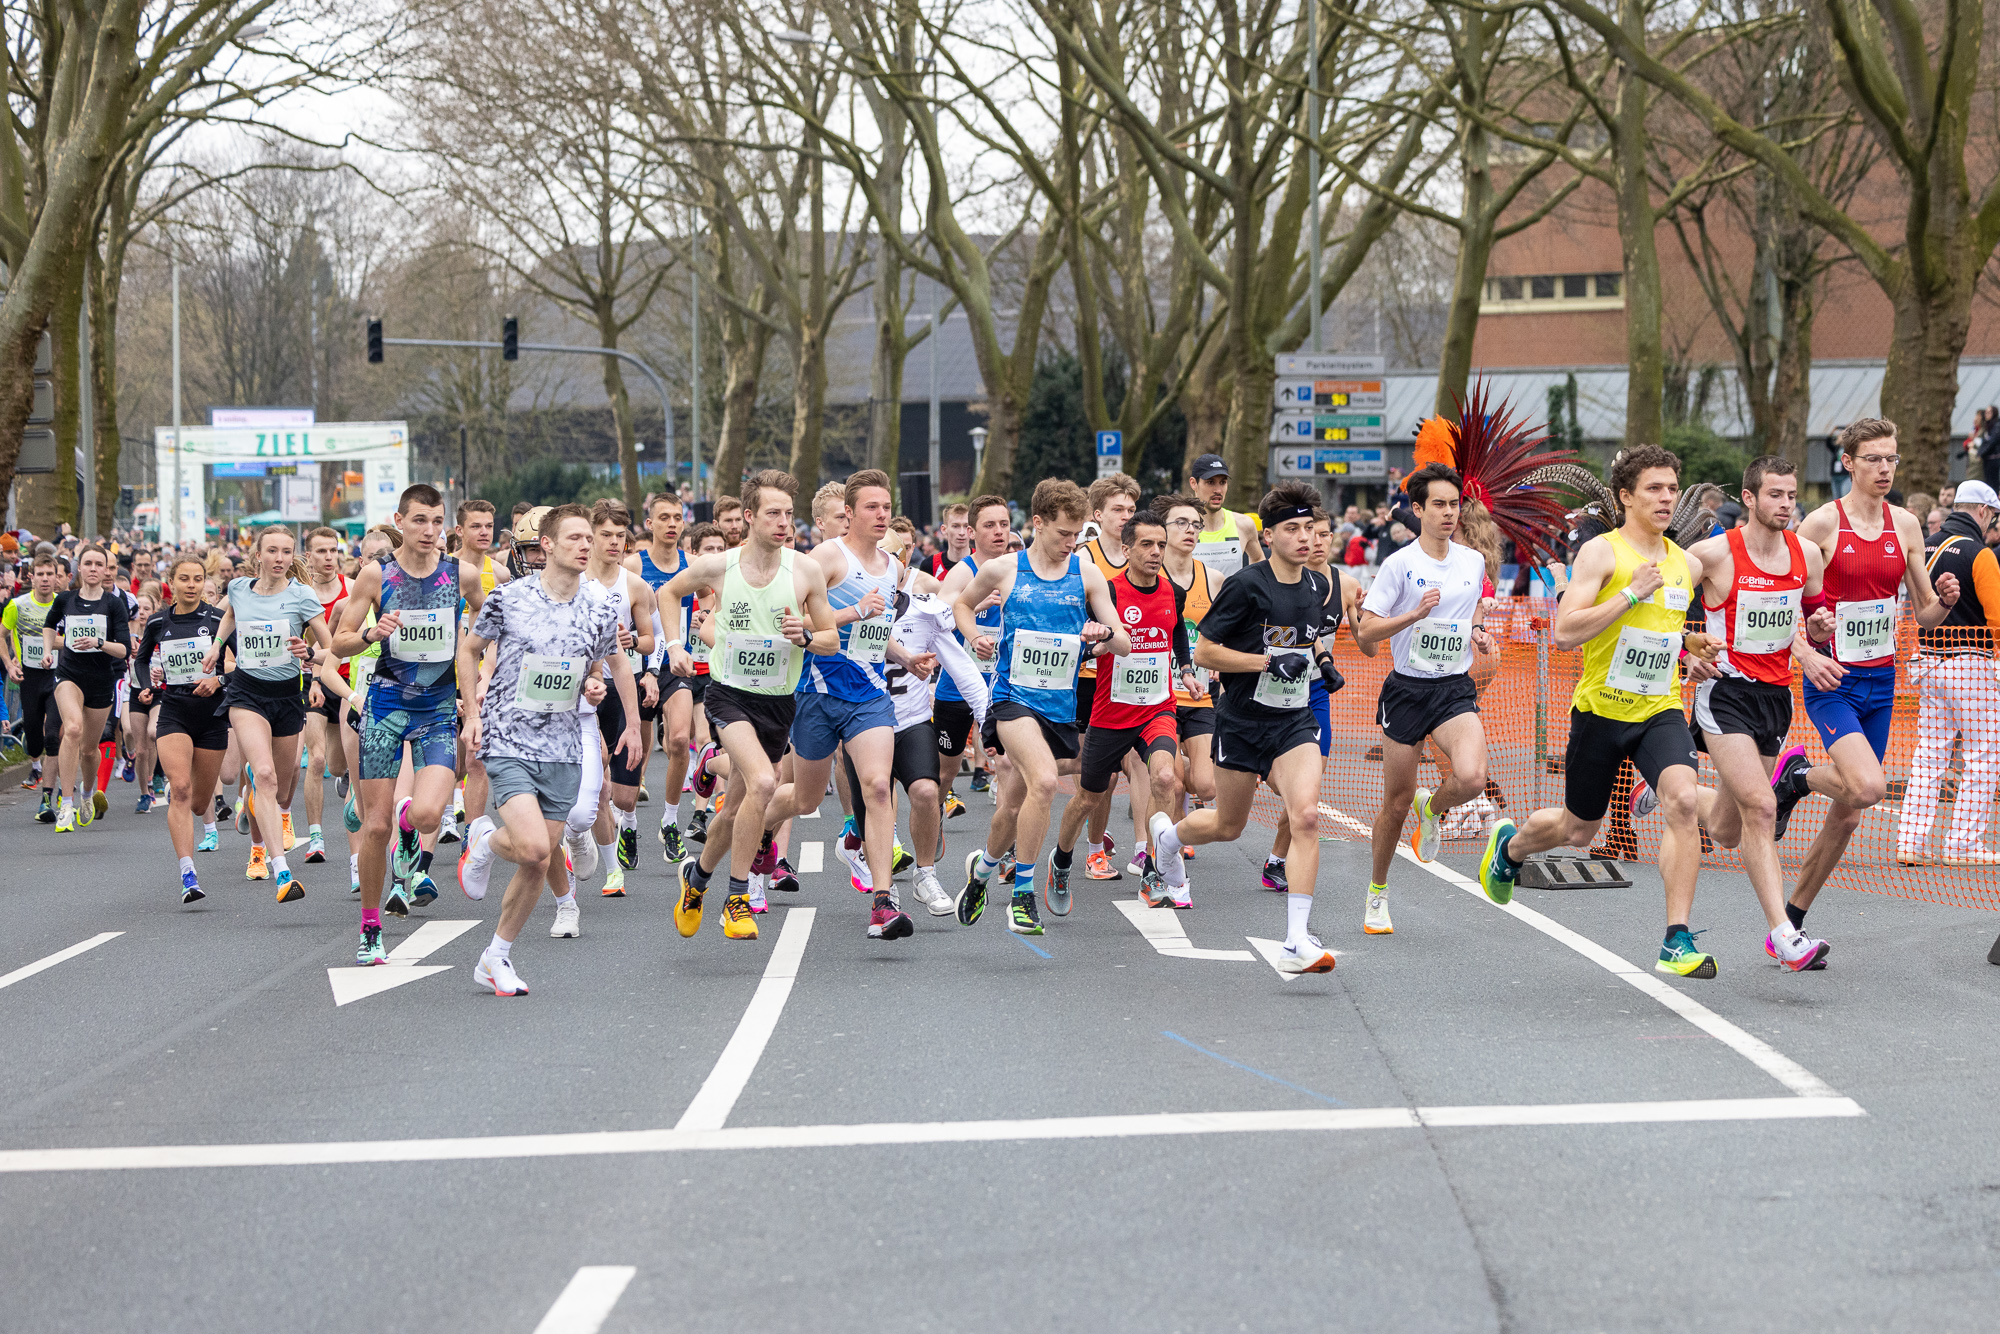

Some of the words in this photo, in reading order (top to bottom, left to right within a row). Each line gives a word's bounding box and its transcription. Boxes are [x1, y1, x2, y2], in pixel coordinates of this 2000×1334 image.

[256, 433, 313, 456] ZIEL
[1102, 434, 1116, 454] P
[1749, 576, 1775, 586] Brillux
[729, 619, 750, 628] AMT
[1747, 609, 1793, 629] 90403
[72, 627, 96, 638] 6358
[400, 625, 444, 641] 90401
[1846, 617, 1889, 637] 90114
[244, 635, 281, 650] 80117
[1420, 634, 1462, 652] 90103
[1858, 638, 1879, 647] Philipp
[168, 651, 204, 667] 90139
[738, 651, 775, 667] 6246
[1022, 648, 1069, 667] 90107
[1428, 652, 1441, 660] Jan
[1442, 653, 1453, 661] Eric
[1625, 648, 1671, 670] 90109
[743, 668, 768, 676] Michiel
[1036, 668, 1052, 676] Felix
[1126, 669, 1159, 684] 6206
[1635, 670, 1656, 681] Julian
[533, 674, 572, 690] 4092
[1598, 691, 1634, 705] VOGTLAND
